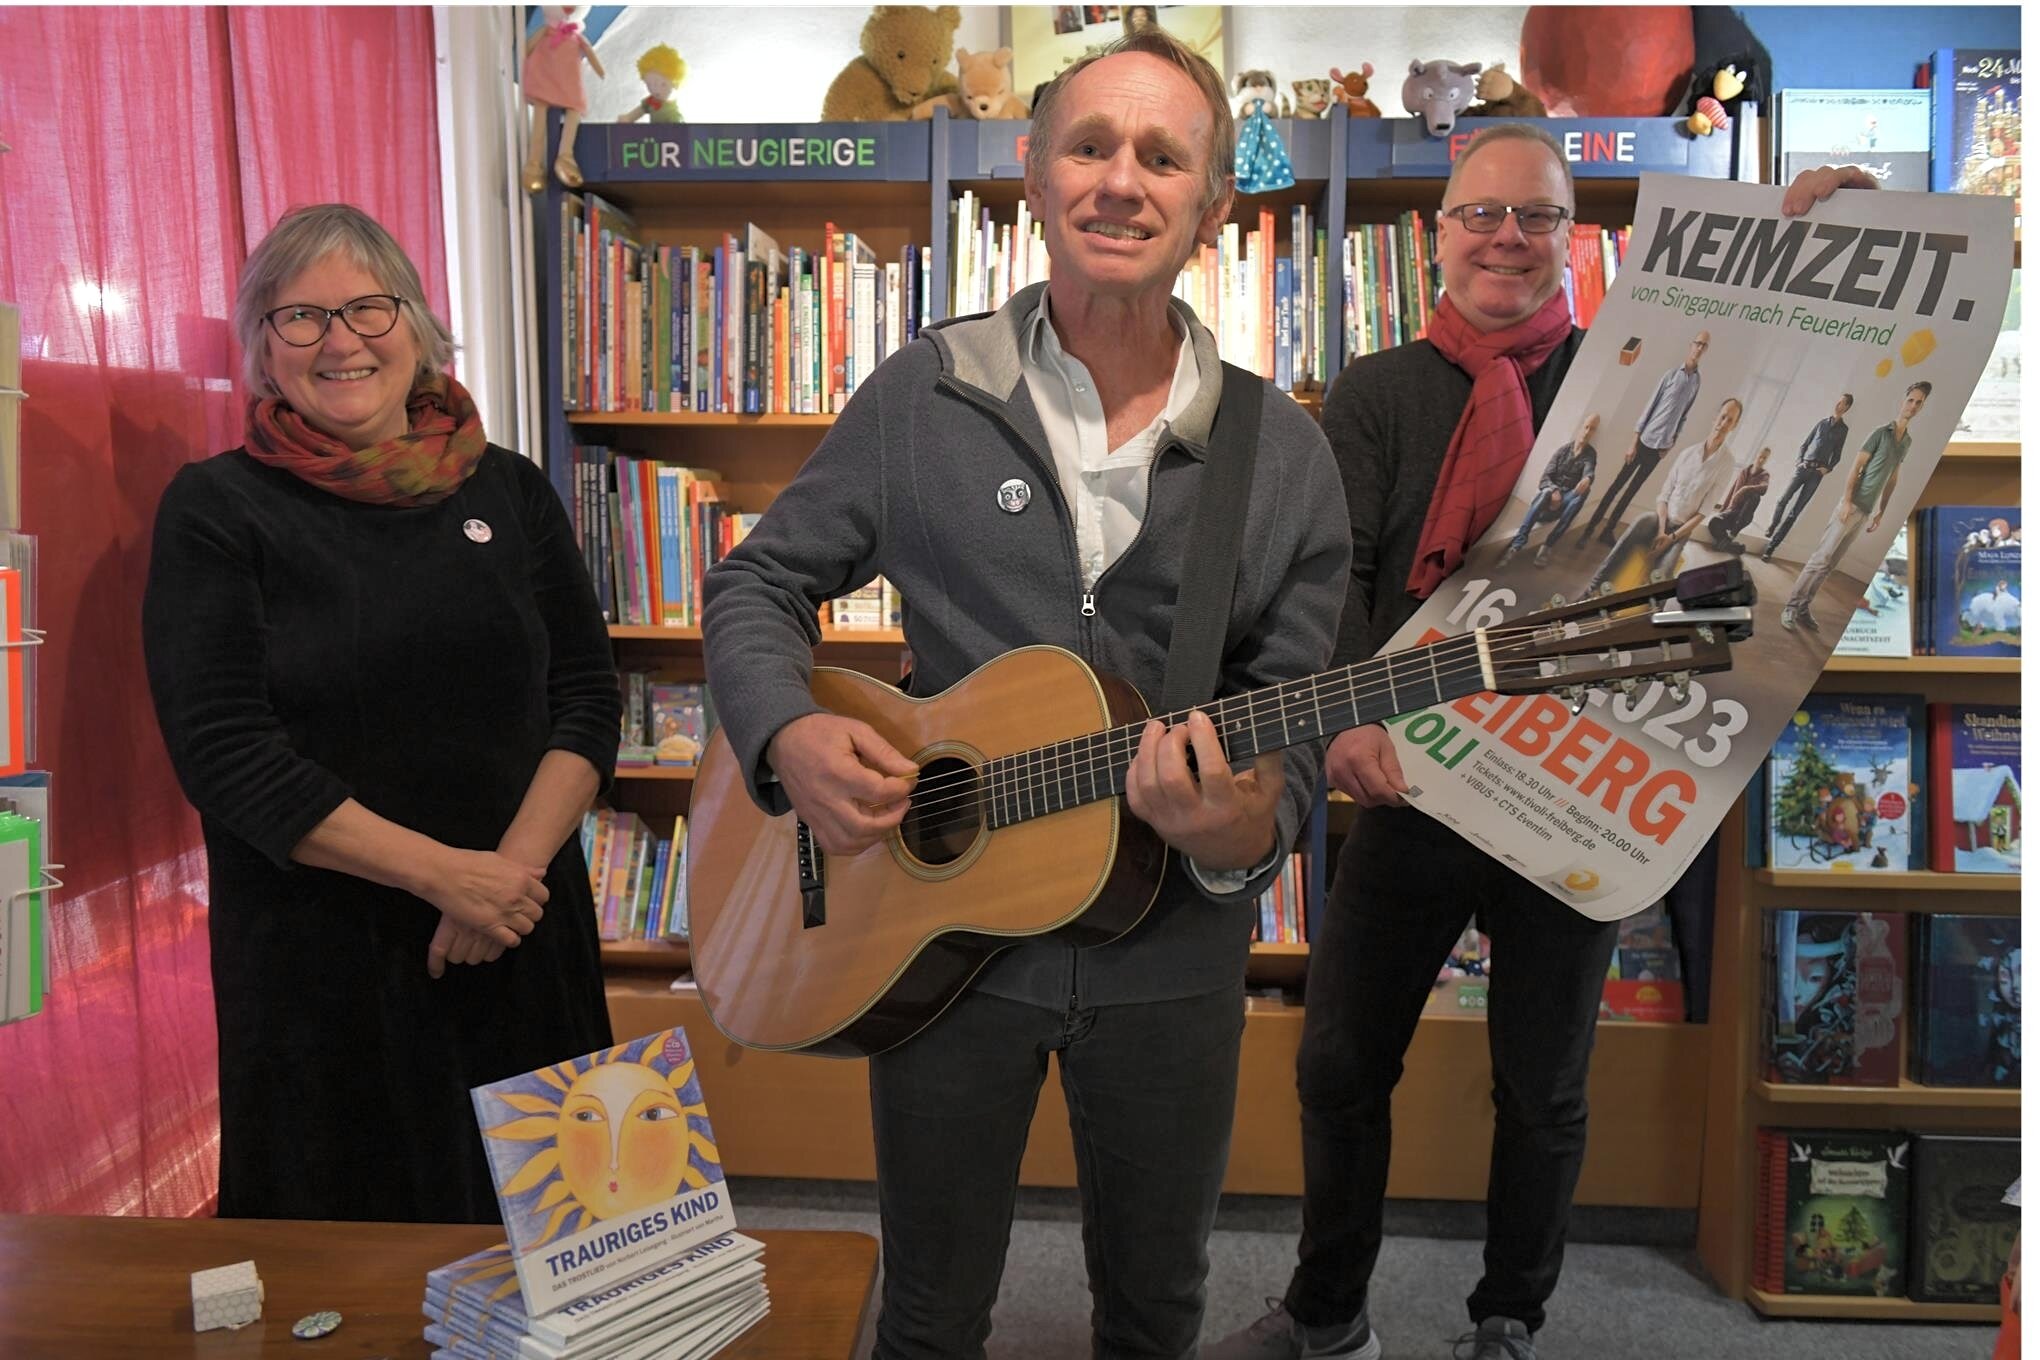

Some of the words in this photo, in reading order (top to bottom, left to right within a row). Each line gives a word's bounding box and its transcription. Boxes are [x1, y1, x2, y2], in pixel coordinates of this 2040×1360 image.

[1978, 57, 2004, 79] 24
[622, 137, 681, 168] FÜR
[693, 137, 876, 168] NEUGIERIGE
[1564, 131, 1636, 163] EINE
[1641, 206, 1975, 322] KEIMZEIT.
[1631, 284, 1662, 305] von
[1662, 286, 1738, 318] Singapur
[1738, 303, 1784, 326] nach
[1787, 306, 1897, 347] Feuerland
[1384, 707, 1480, 770] OLI
[1415, 627, 1697, 846] EIBERG
[1584, 680, 1749, 768] 023
[1466, 775, 1496, 799] VIBUS
[1498, 799, 1520, 816] CTS
[1516, 812, 1553, 841] Eventim
[1472, 760, 1505, 787] Tickets:
[1503, 783, 1597, 851] www.tivoli-freiberg.de
[1484, 748, 1515, 775] Einlass:
[1515, 770, 1540, 790] 18.30
[1537, 785, 1556, 801] Uhr
[1566, 804, 1602, 834] Beginn:
[1601, 829, 1632, 852] 20.00
[1630, 847, 1651, 865] Uhr
[545, 1212, 669, 1277] TRAURIGES
[670, 1191, 719, 1225] KIND
[552, 1281, 568, 1292] DAS
[568, 1264, 606, 1285] TROSTLIED
